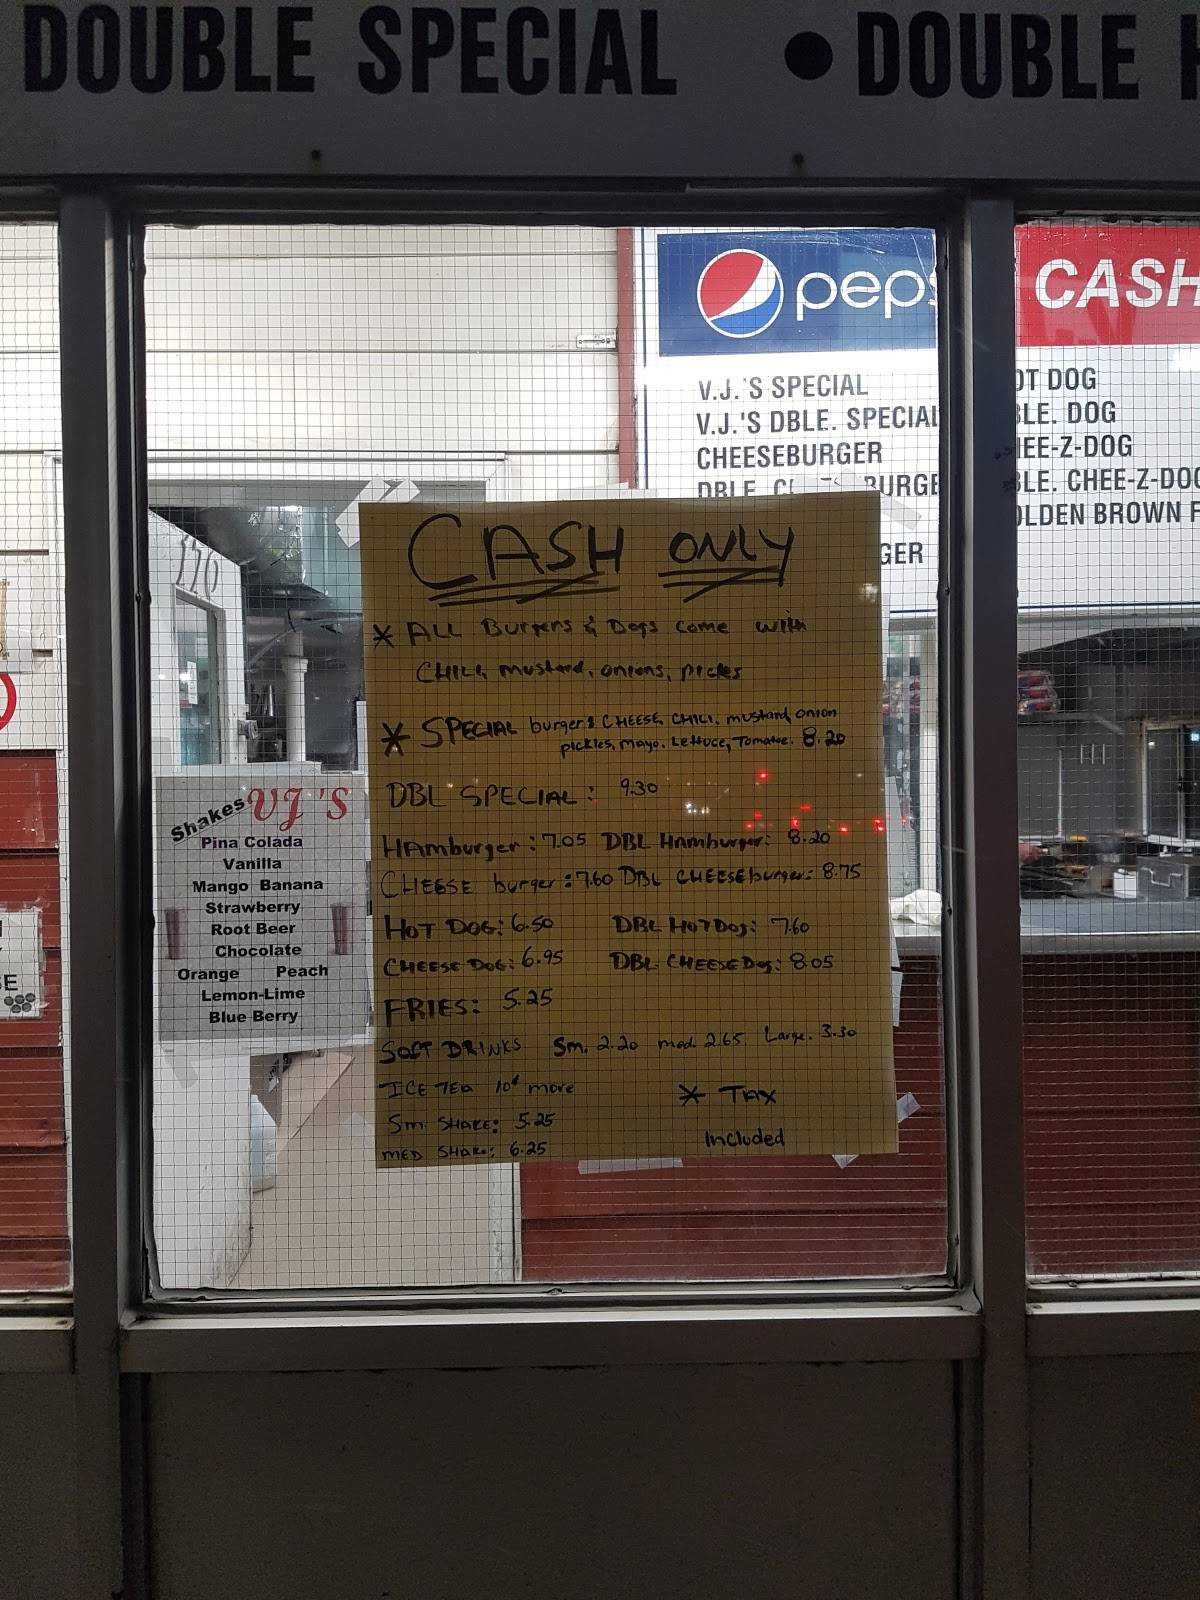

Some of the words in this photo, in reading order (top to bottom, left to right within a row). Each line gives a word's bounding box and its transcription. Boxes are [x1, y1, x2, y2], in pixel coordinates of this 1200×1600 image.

[23, 6, 315, 93] DOUBLE
[358, 6, 678, 96] SPECIAL
[857, 11, 1139, 100] DOUBLE
[1035, 258, 1200, 310] CASH
[772, 374, 869, 398] SPECIAL
[1048, 367, 1096, 390] DOG
[771, 409, 837, 433] DBLE.
[1068, 401, 1117, 424] DOG
[697, 442, 883, 470] CHEESEBURGER
[1016, 434, 1132, 459] EE-Z-DOG
[1094, 501, 1181, 525] BROWN
[407, 512, 624, 590] CASH
[669, 523, 795, 587] ONLY
[406, 621, 462, 647] ALL
[386, 781, 448, 809] DBL
[170, 797, 246, 843] Shakes
[201, 837, 239, 849] Pina
[244, 836, 304, 849] Colada
[223, 858, 283, 870] Vanilla
[193, 881, 249, 895] Mango
[260, 879, 324, 891] Banana
[205, 902, 301, 915] Strawberry
[211, 923, 250, 936] Root
[256, 922, 296, 935] Beer
[215, 943, 303, 957] Chocolate
[177, 968, 240, 983] Orange
[276, 965, 329, 978] Peach
[201, 987, 306, 1002] Lemon-Lime
[209, 1010, 247, 1024] Blue
[252, 1009, 299, 1024] Berry
[441, 1037, 523, 1059] DRINKS
